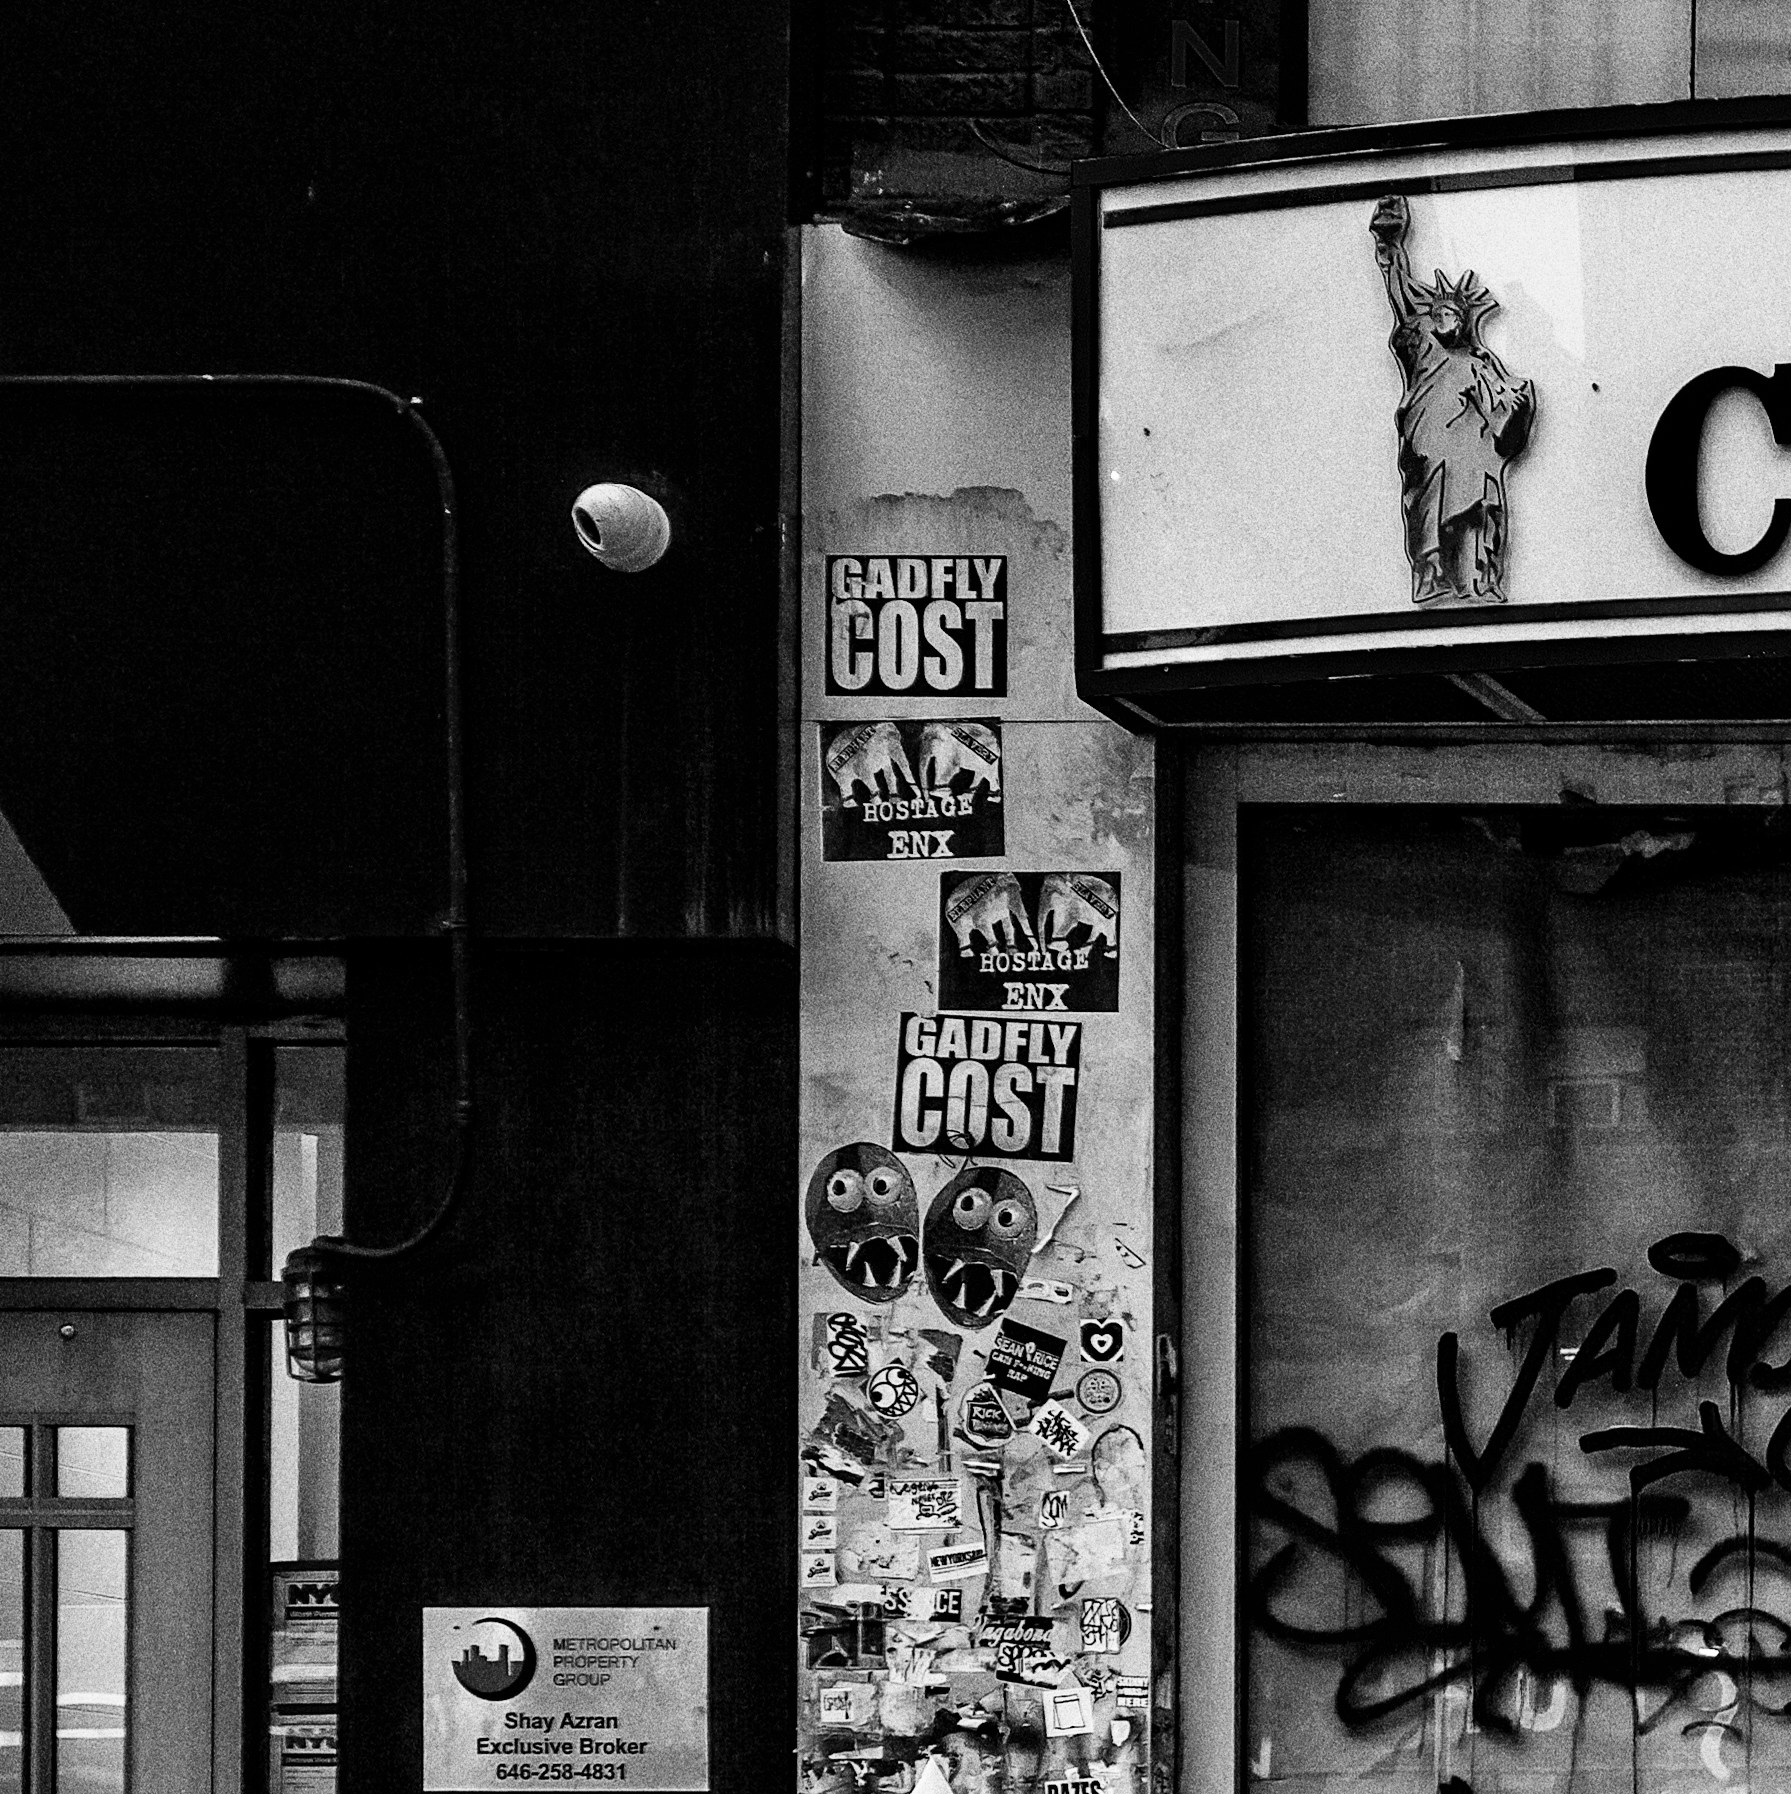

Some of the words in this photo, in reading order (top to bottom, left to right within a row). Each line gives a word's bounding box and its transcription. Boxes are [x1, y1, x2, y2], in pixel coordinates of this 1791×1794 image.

[831, 557, 1002, 600] GADFLY
[831, 600, 1004, 691] COST
[863, 795, 974, 822] HOSTAGE
[887, 830, 954, 858] ENX
[979, 950, 1088, 973] HOSTAGE
[1002, 982, 1068, 1011] ENX
[905, 1014, 1078, 1064] GADFLY
[901, 1060, 1075, 1155] COST
[553, 1638, 676, 1651] METROPOLITAN
[553, 1656, 638, 1668] PROPERTY
[553, 1673, 611, 1686] GROUP
[504, 1711, 556, 1734] Shay
[559, 1712, 618, 1730] Azran
[477, 1737, 573, 1755] Exclusive
[579, 1737, 647, 1755] Broker
[496, 1763, 626, 1781] 646-258-4831
